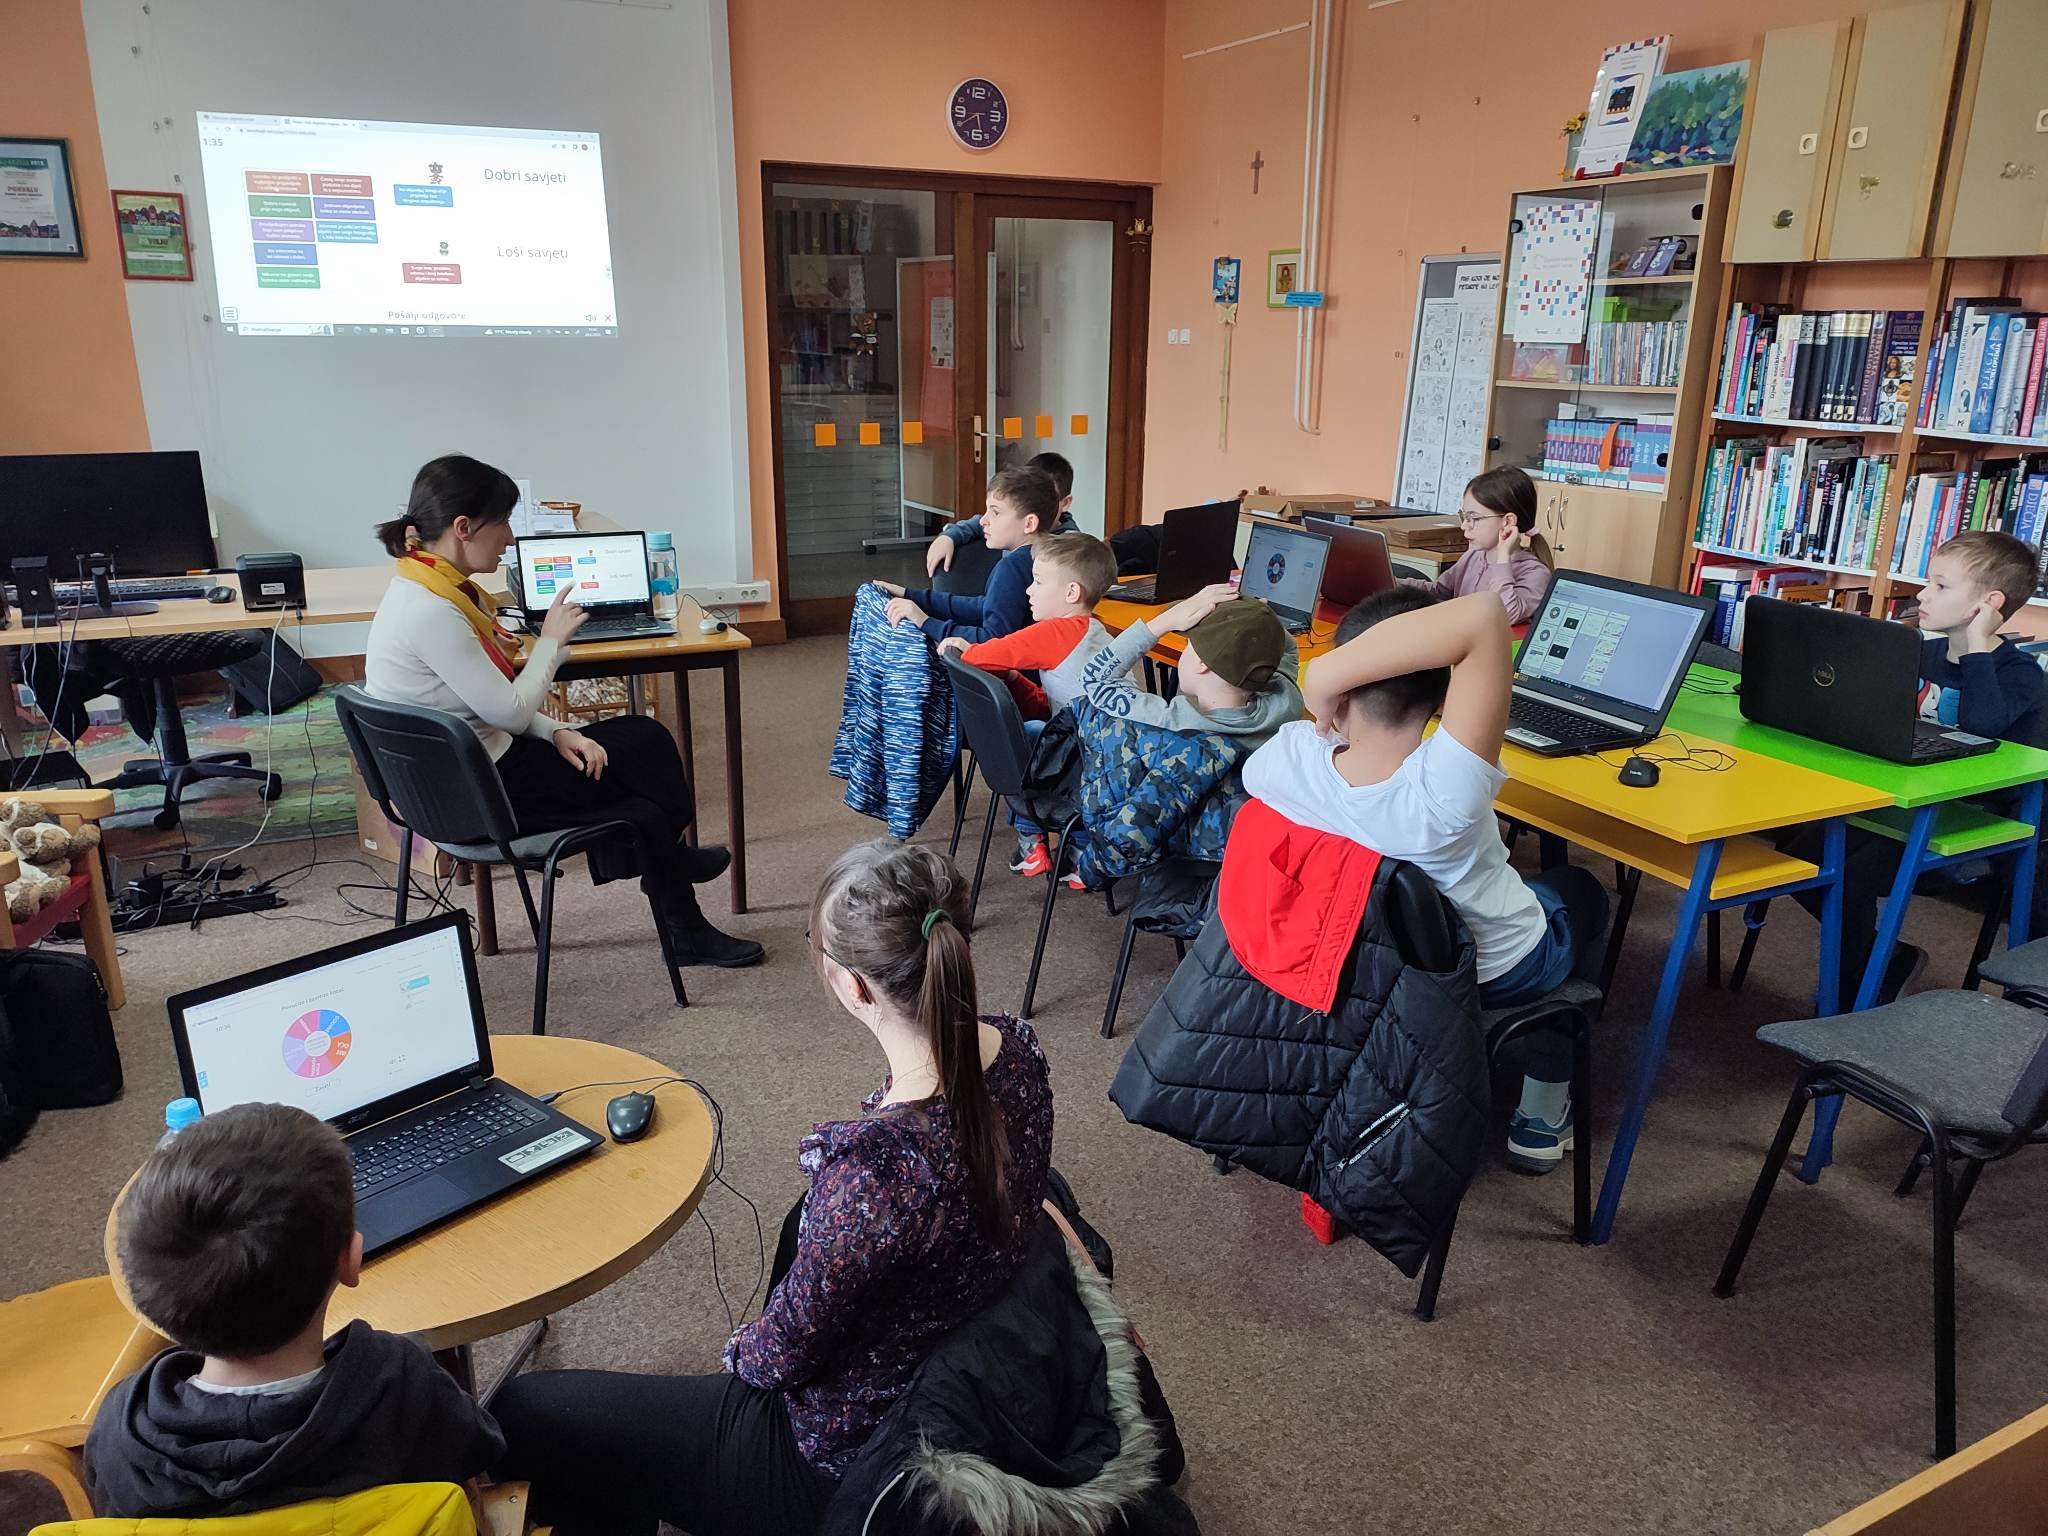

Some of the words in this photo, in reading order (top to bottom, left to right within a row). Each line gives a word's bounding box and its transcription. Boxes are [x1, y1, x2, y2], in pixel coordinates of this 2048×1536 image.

[972, 87, 986, 99] 12
[955, 106, 966, 118] 9
[990, 110, 1001, 122] 3
[972, 129, 983, 141] 6
[203, 138, 224, 147] 1:35
[484, 168, 521, 182] Dobri
[525, 171, 566, 186] savjeti
[497, 246, 525, 258] Loši
[528, 248, 568, 262] savjeti
